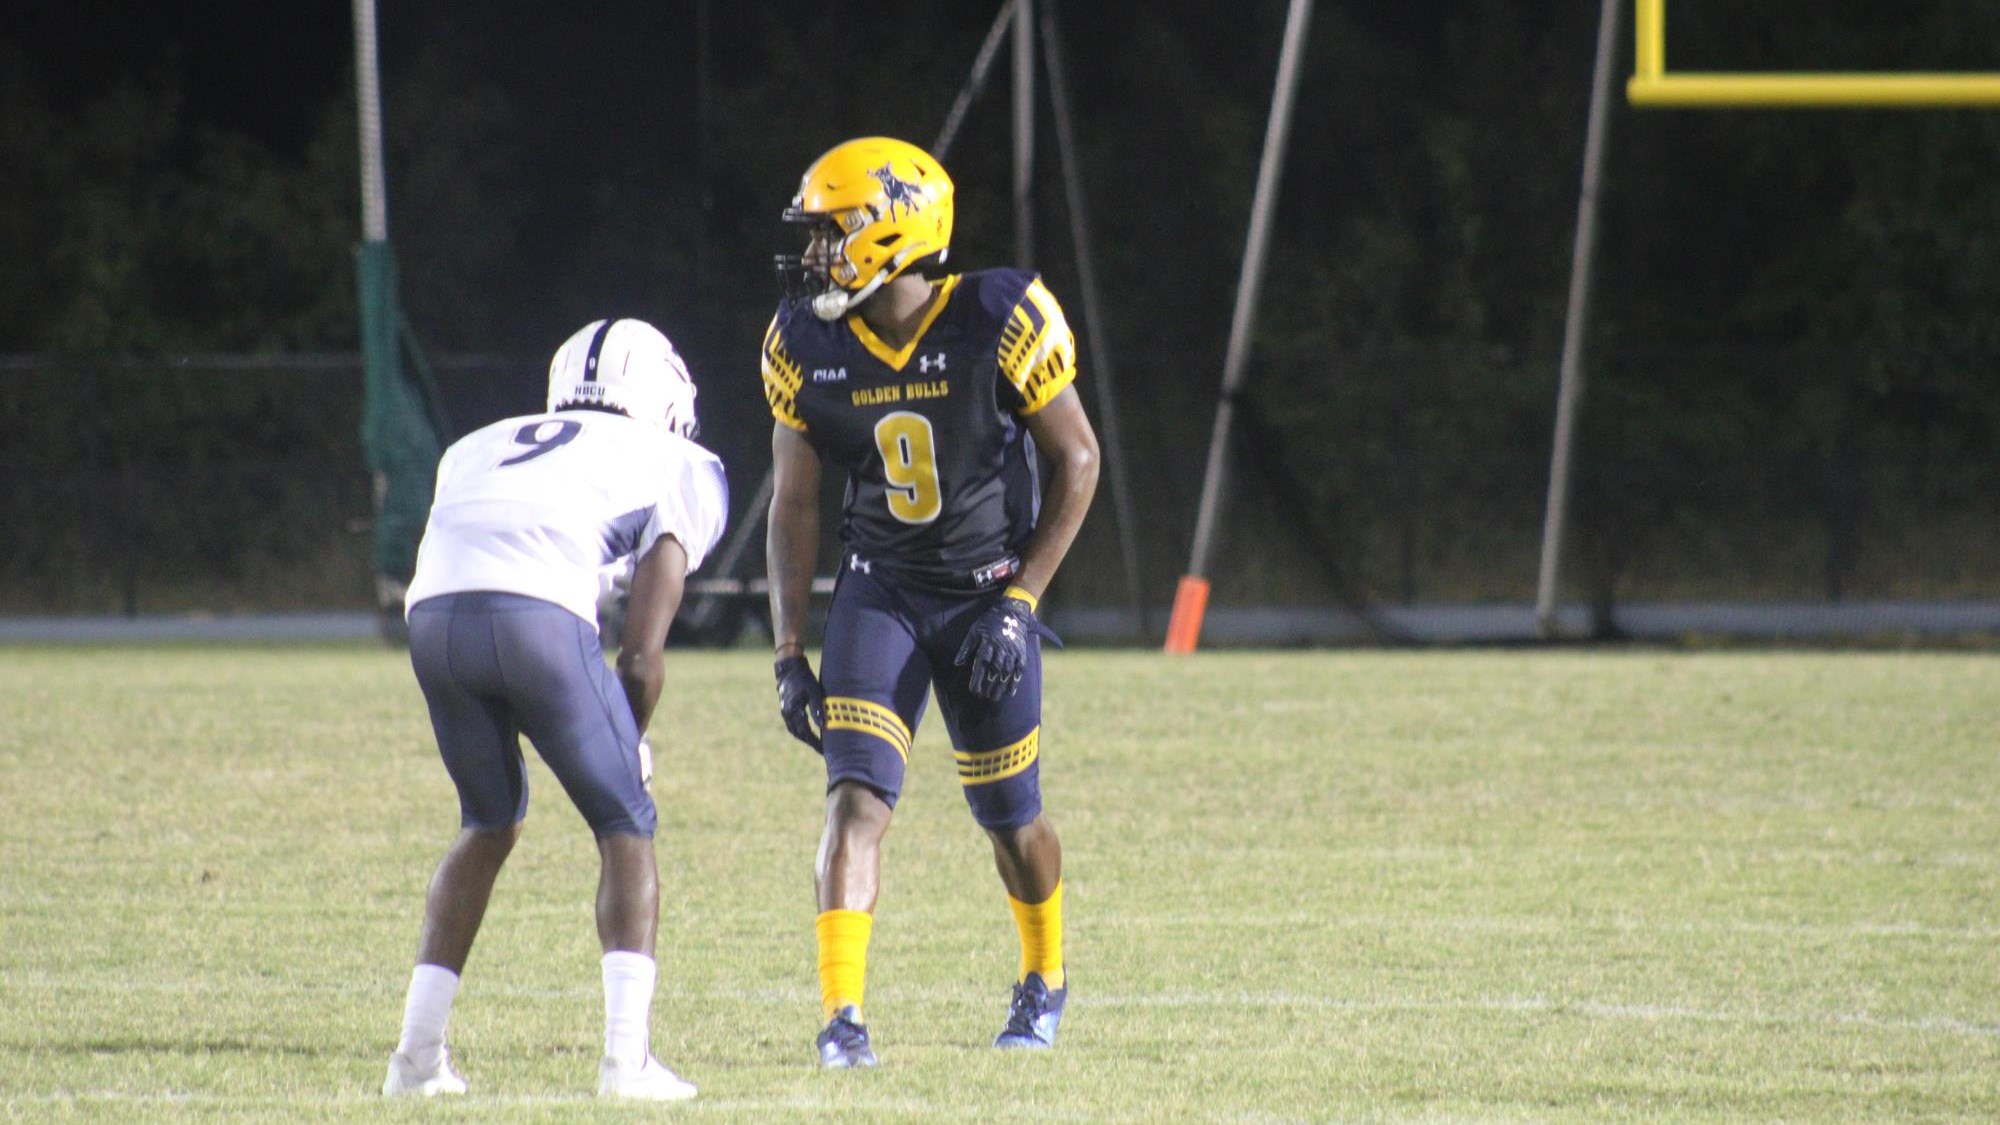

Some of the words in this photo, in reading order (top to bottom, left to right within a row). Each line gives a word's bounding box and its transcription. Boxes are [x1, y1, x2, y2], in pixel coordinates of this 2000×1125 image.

[813, 367, 847, 382] CIAA
[574, 384, 606, 396] HBCU
[851, 385, 900, 406] GOLDEN
[906, 380, 949, 400] BULLS
[498, 420, 583, 467] 9
[874, 411, 942, 524] 9
